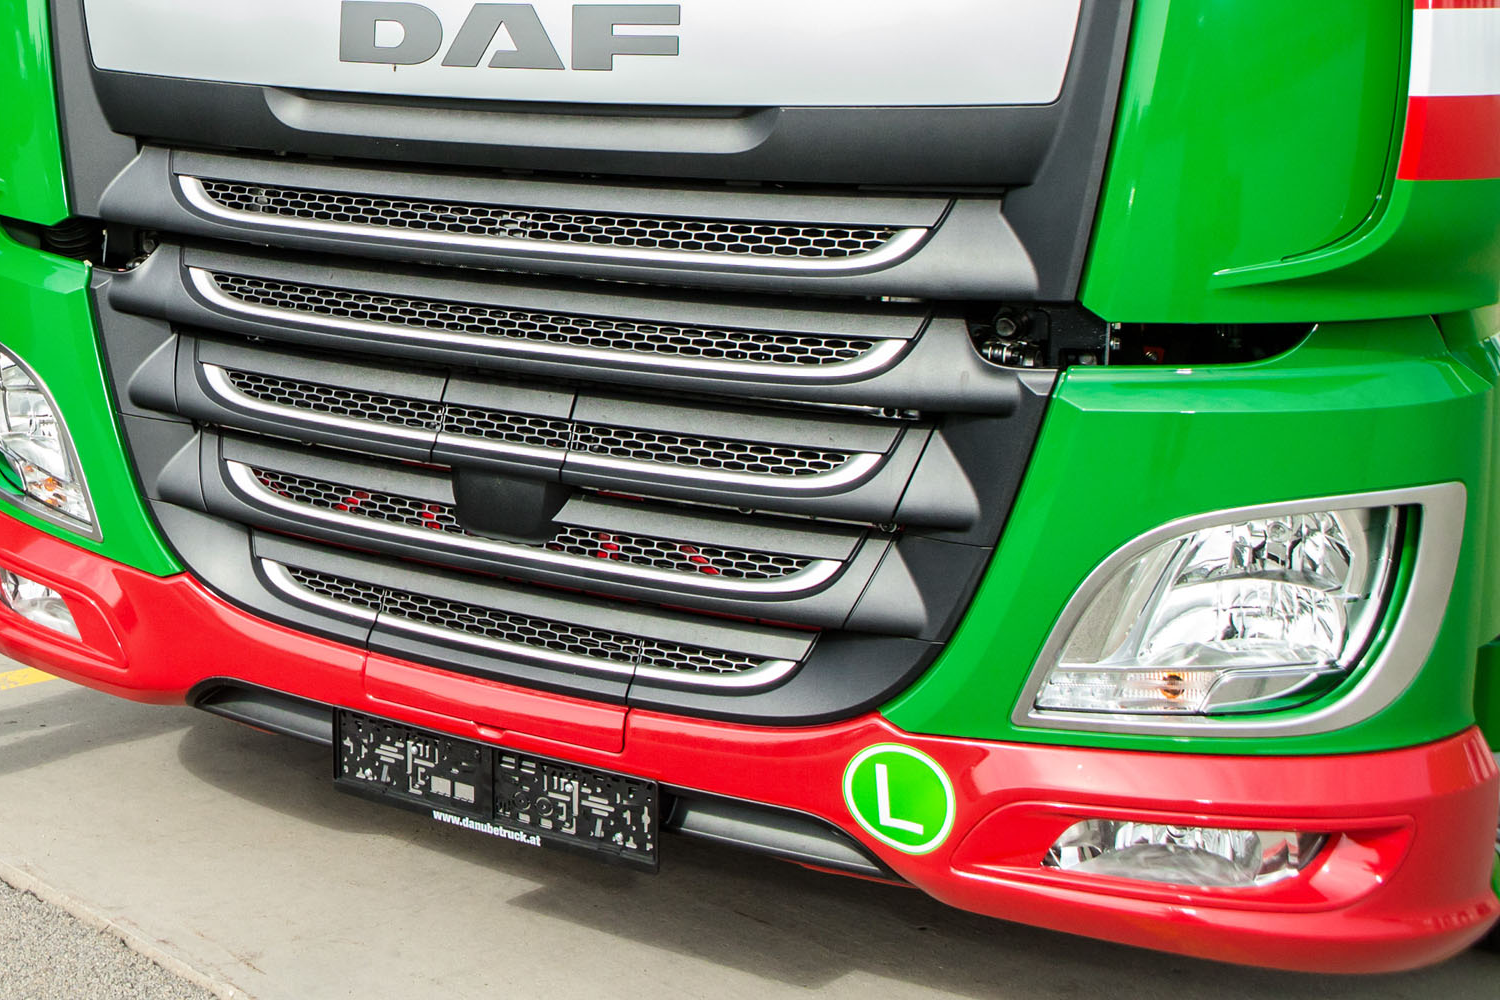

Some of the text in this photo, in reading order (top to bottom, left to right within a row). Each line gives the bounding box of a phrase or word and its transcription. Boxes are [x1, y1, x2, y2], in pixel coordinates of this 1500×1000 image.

[340, 0, 680, 72] DAF
[432, 808, 541, 847] www.danubetruck.at
[875, 763, 924, 835] L
